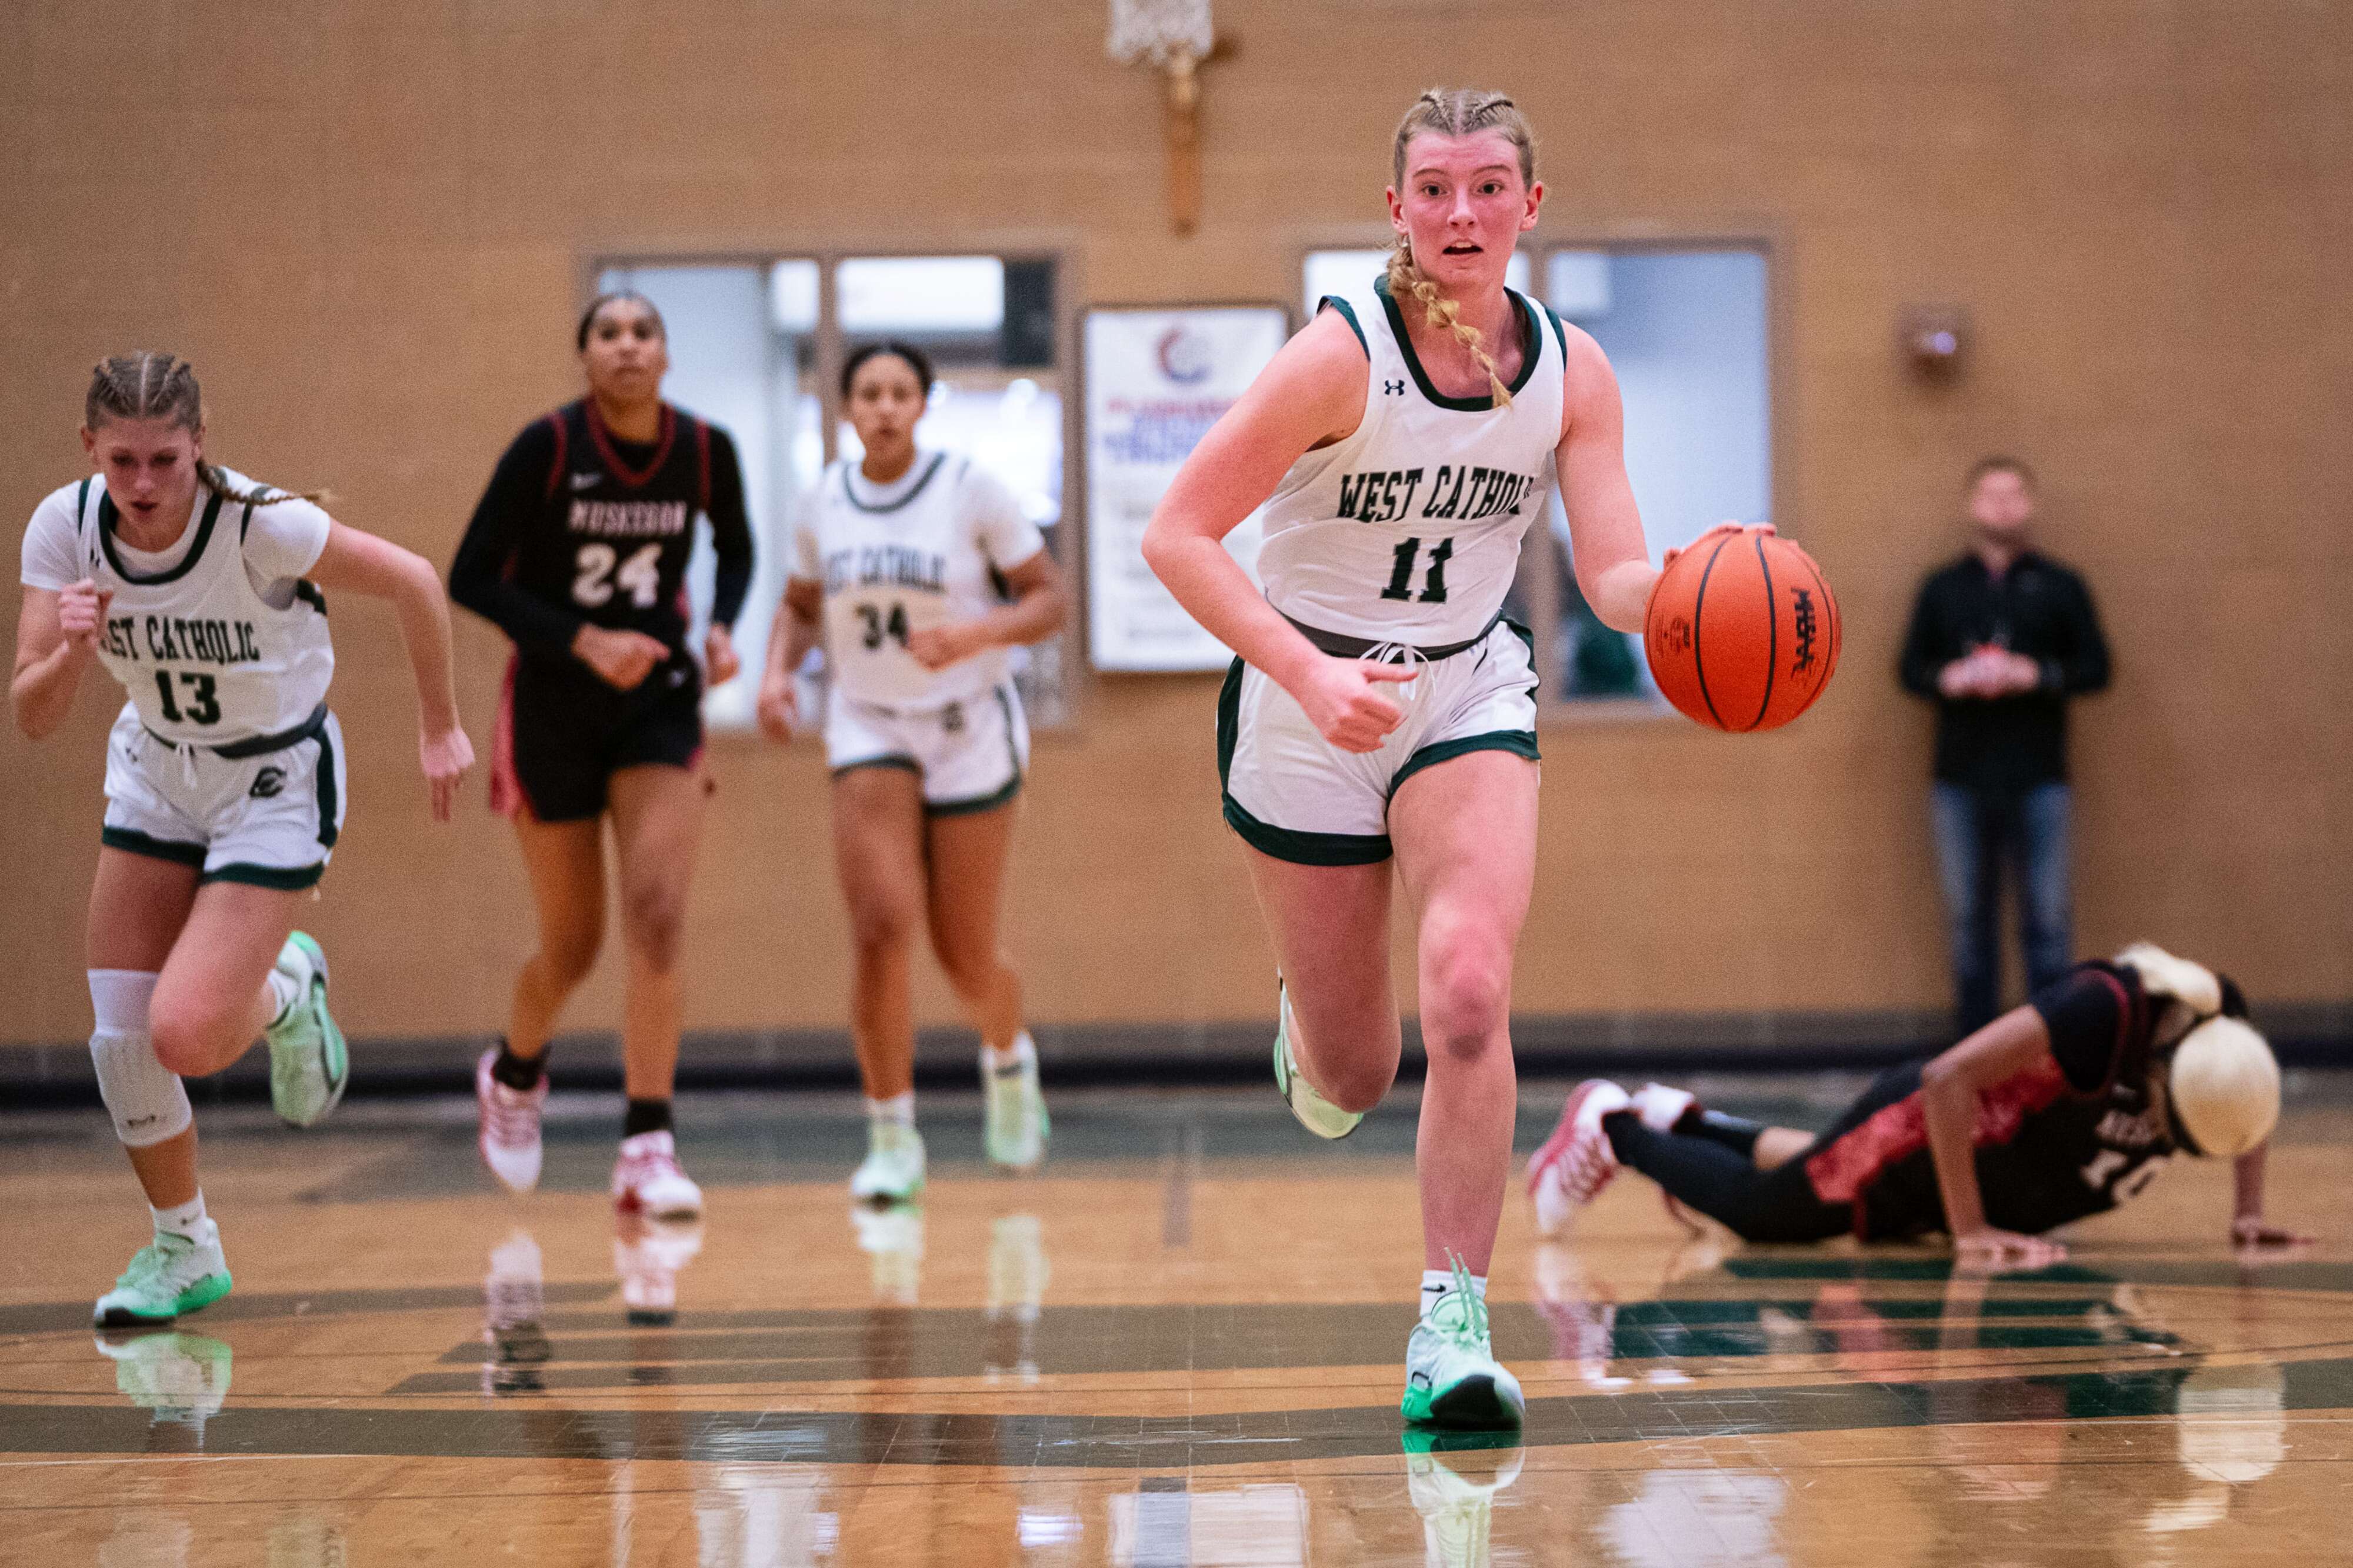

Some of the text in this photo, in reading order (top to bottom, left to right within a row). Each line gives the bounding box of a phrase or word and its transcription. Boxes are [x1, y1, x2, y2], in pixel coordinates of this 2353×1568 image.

[1336, 465, 1534, 523] WEST CATHOLI
[571, 542, 663, 609] 24
[1380, 536, 1455, 604] 11
[101, 615, 260, 665] ST CATHOLIC
[855, 601, 909, 650] 34
[155, 669, 221, 725] 13
